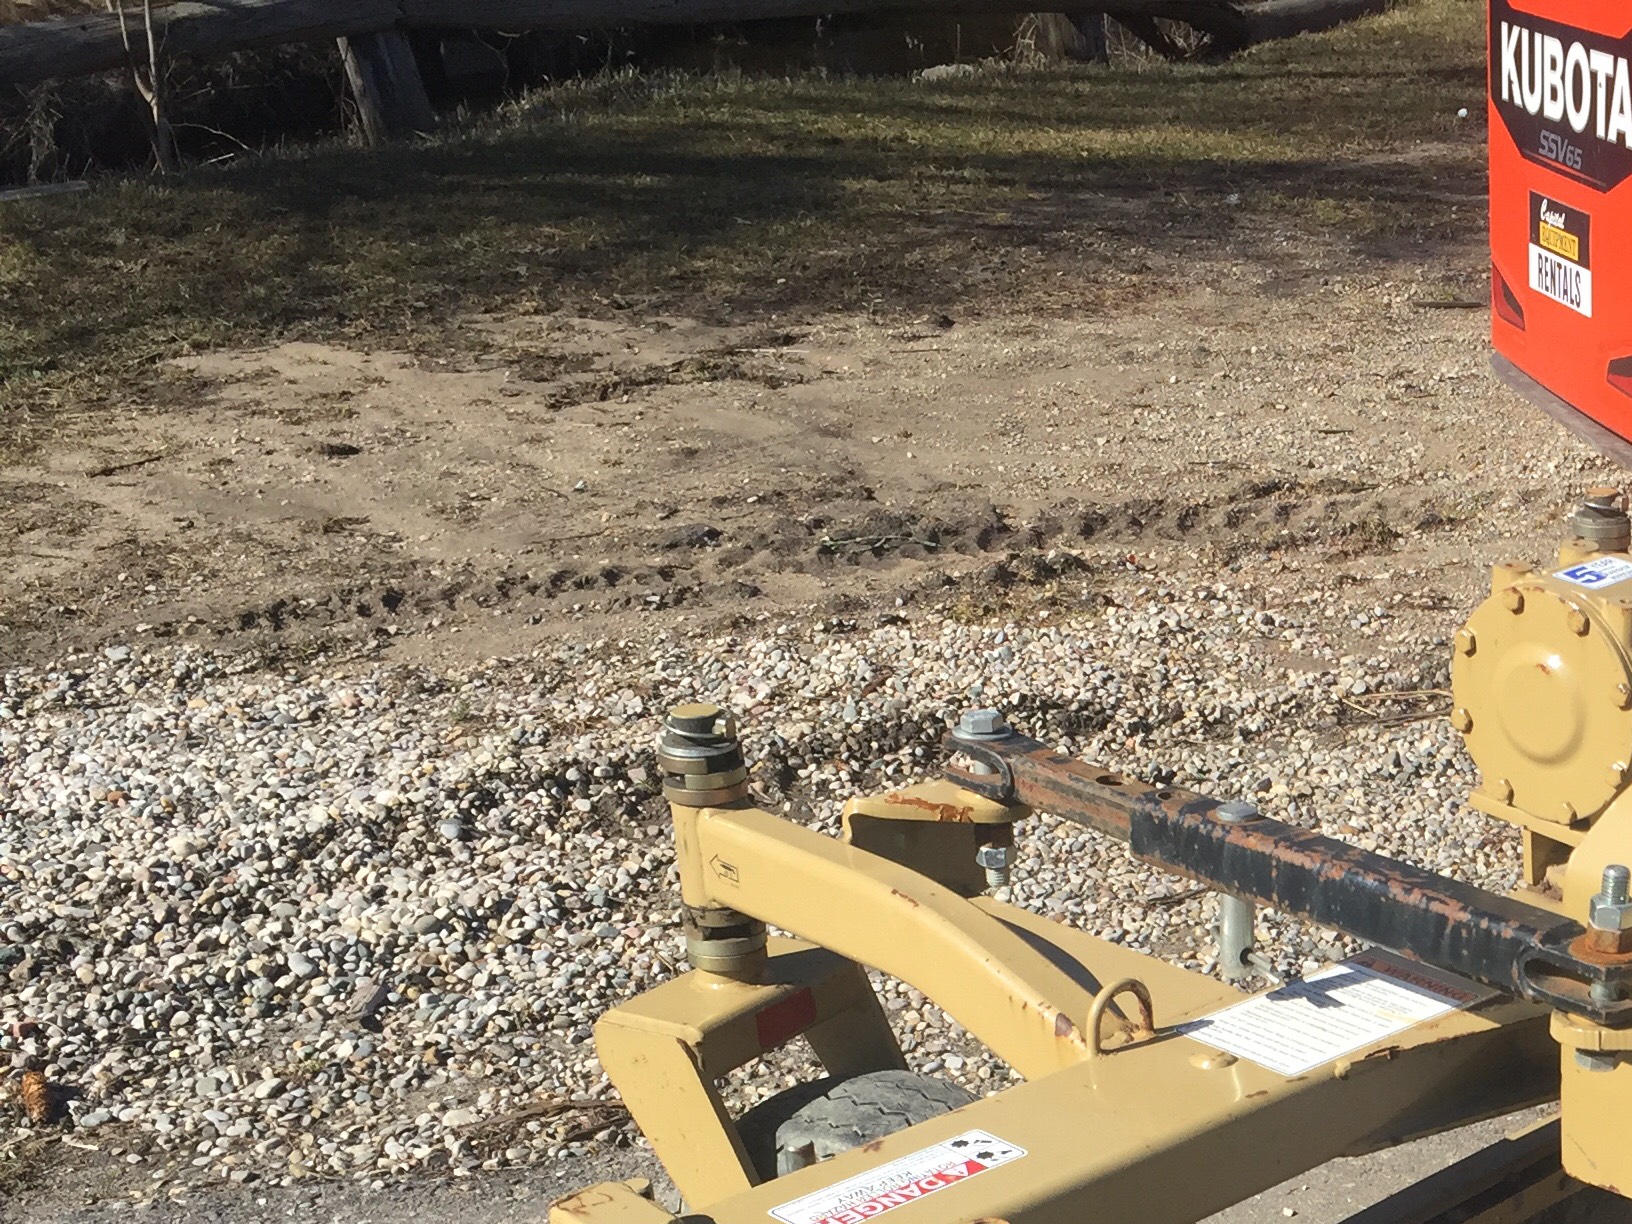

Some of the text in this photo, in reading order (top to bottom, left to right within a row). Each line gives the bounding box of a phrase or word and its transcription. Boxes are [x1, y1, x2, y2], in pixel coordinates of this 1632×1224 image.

[1538, 129, 1583, 169] SSV65
[1538, 252, 1581, 308] RENTALS
[1563, 566, 1608, 583] 5
[833, 1170, 913, 1203] KEEP AWAY
